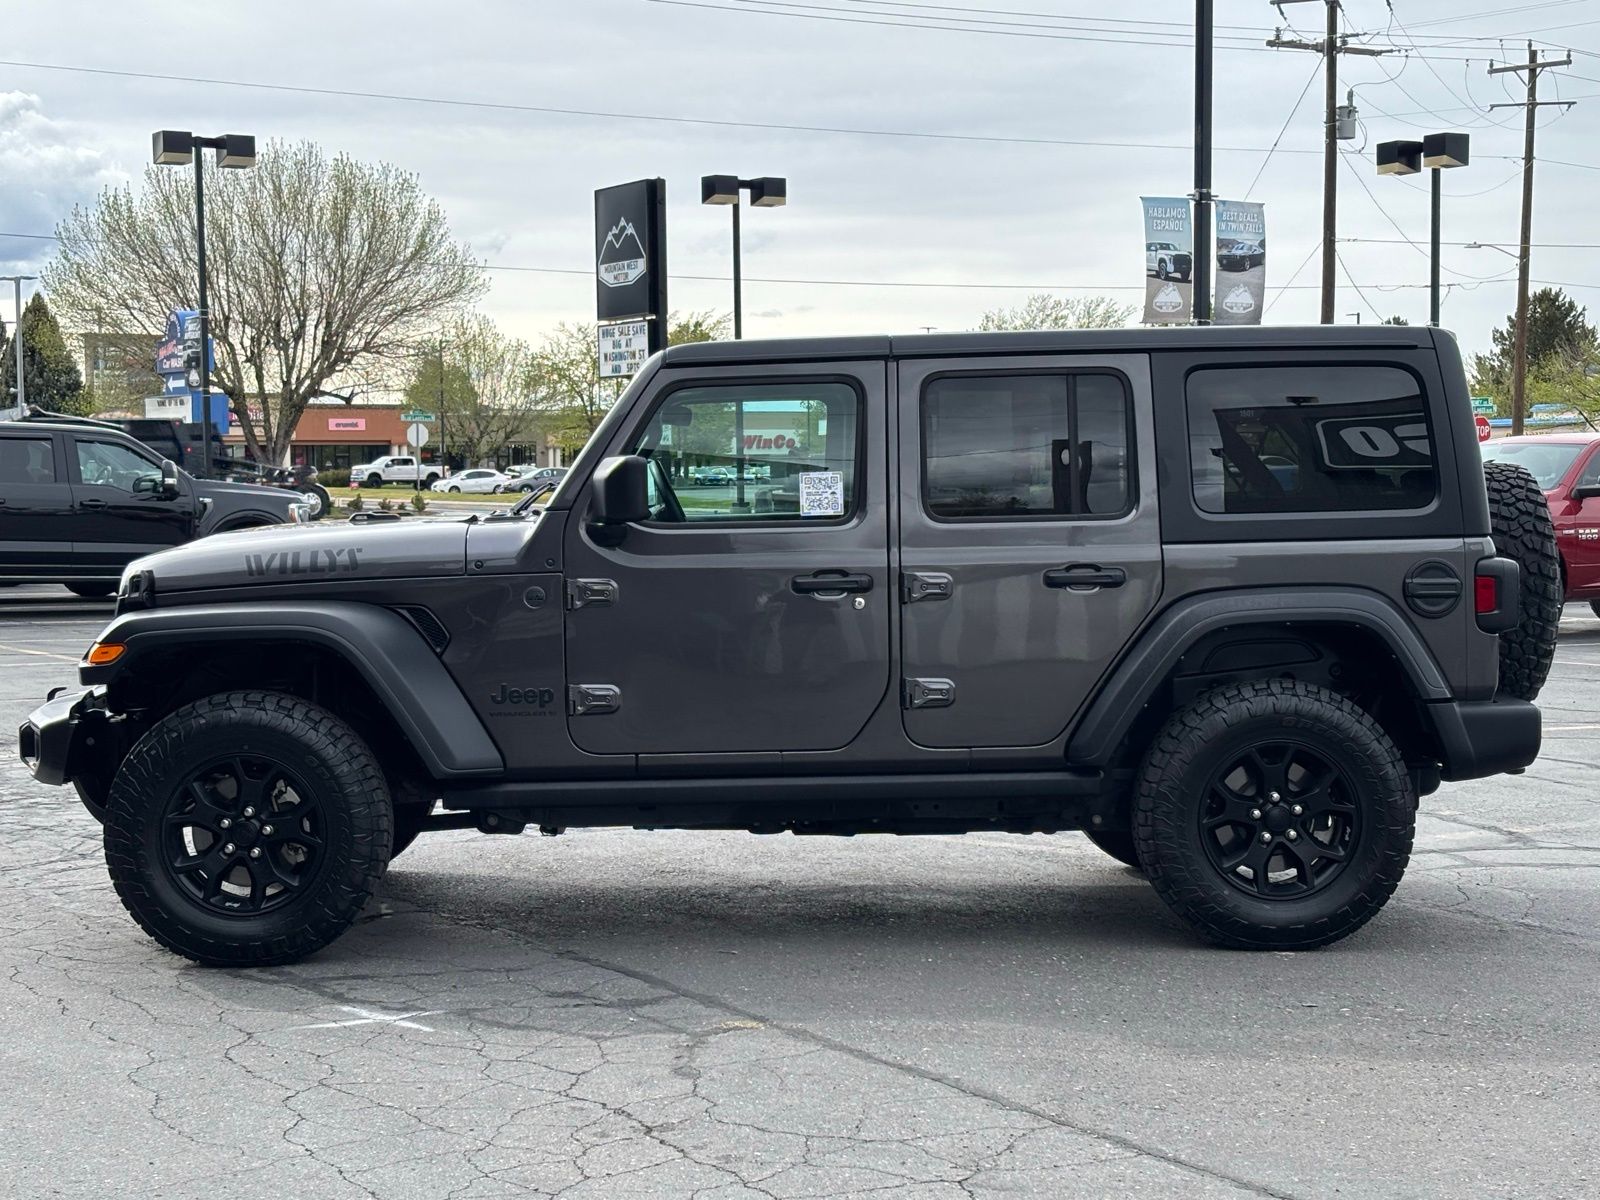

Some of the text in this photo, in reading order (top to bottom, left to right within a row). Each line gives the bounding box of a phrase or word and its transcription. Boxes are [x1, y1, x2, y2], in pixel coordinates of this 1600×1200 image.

[1148, 207, 1186, 218] HABLAMOS
[1222, 212, 1258, 222] BEST DEALS
[1153, 218, 1184, 231] ESPAÑOL
[1218, 222, 1263, 233] IN TWIN FALLS
[604, 260, 639, 273] MOUNTAIN WEST
[613, 271, 630, 281] MOTOR
[617, 325, 631, 337] SALE
[631, 324, 646, 336] SAVE
[612, 338, 632, 349] BIG AT
[603, 349, 646, 362] WASHINGTON ST
[611, 364, 622, 374] AND
[1475, 425, 1490, 437] TOP
[742, 434, 796, 449] WinCo
[244, 548, 363, 577] WILLYS
[490, 683, 554, 708] Jeep
